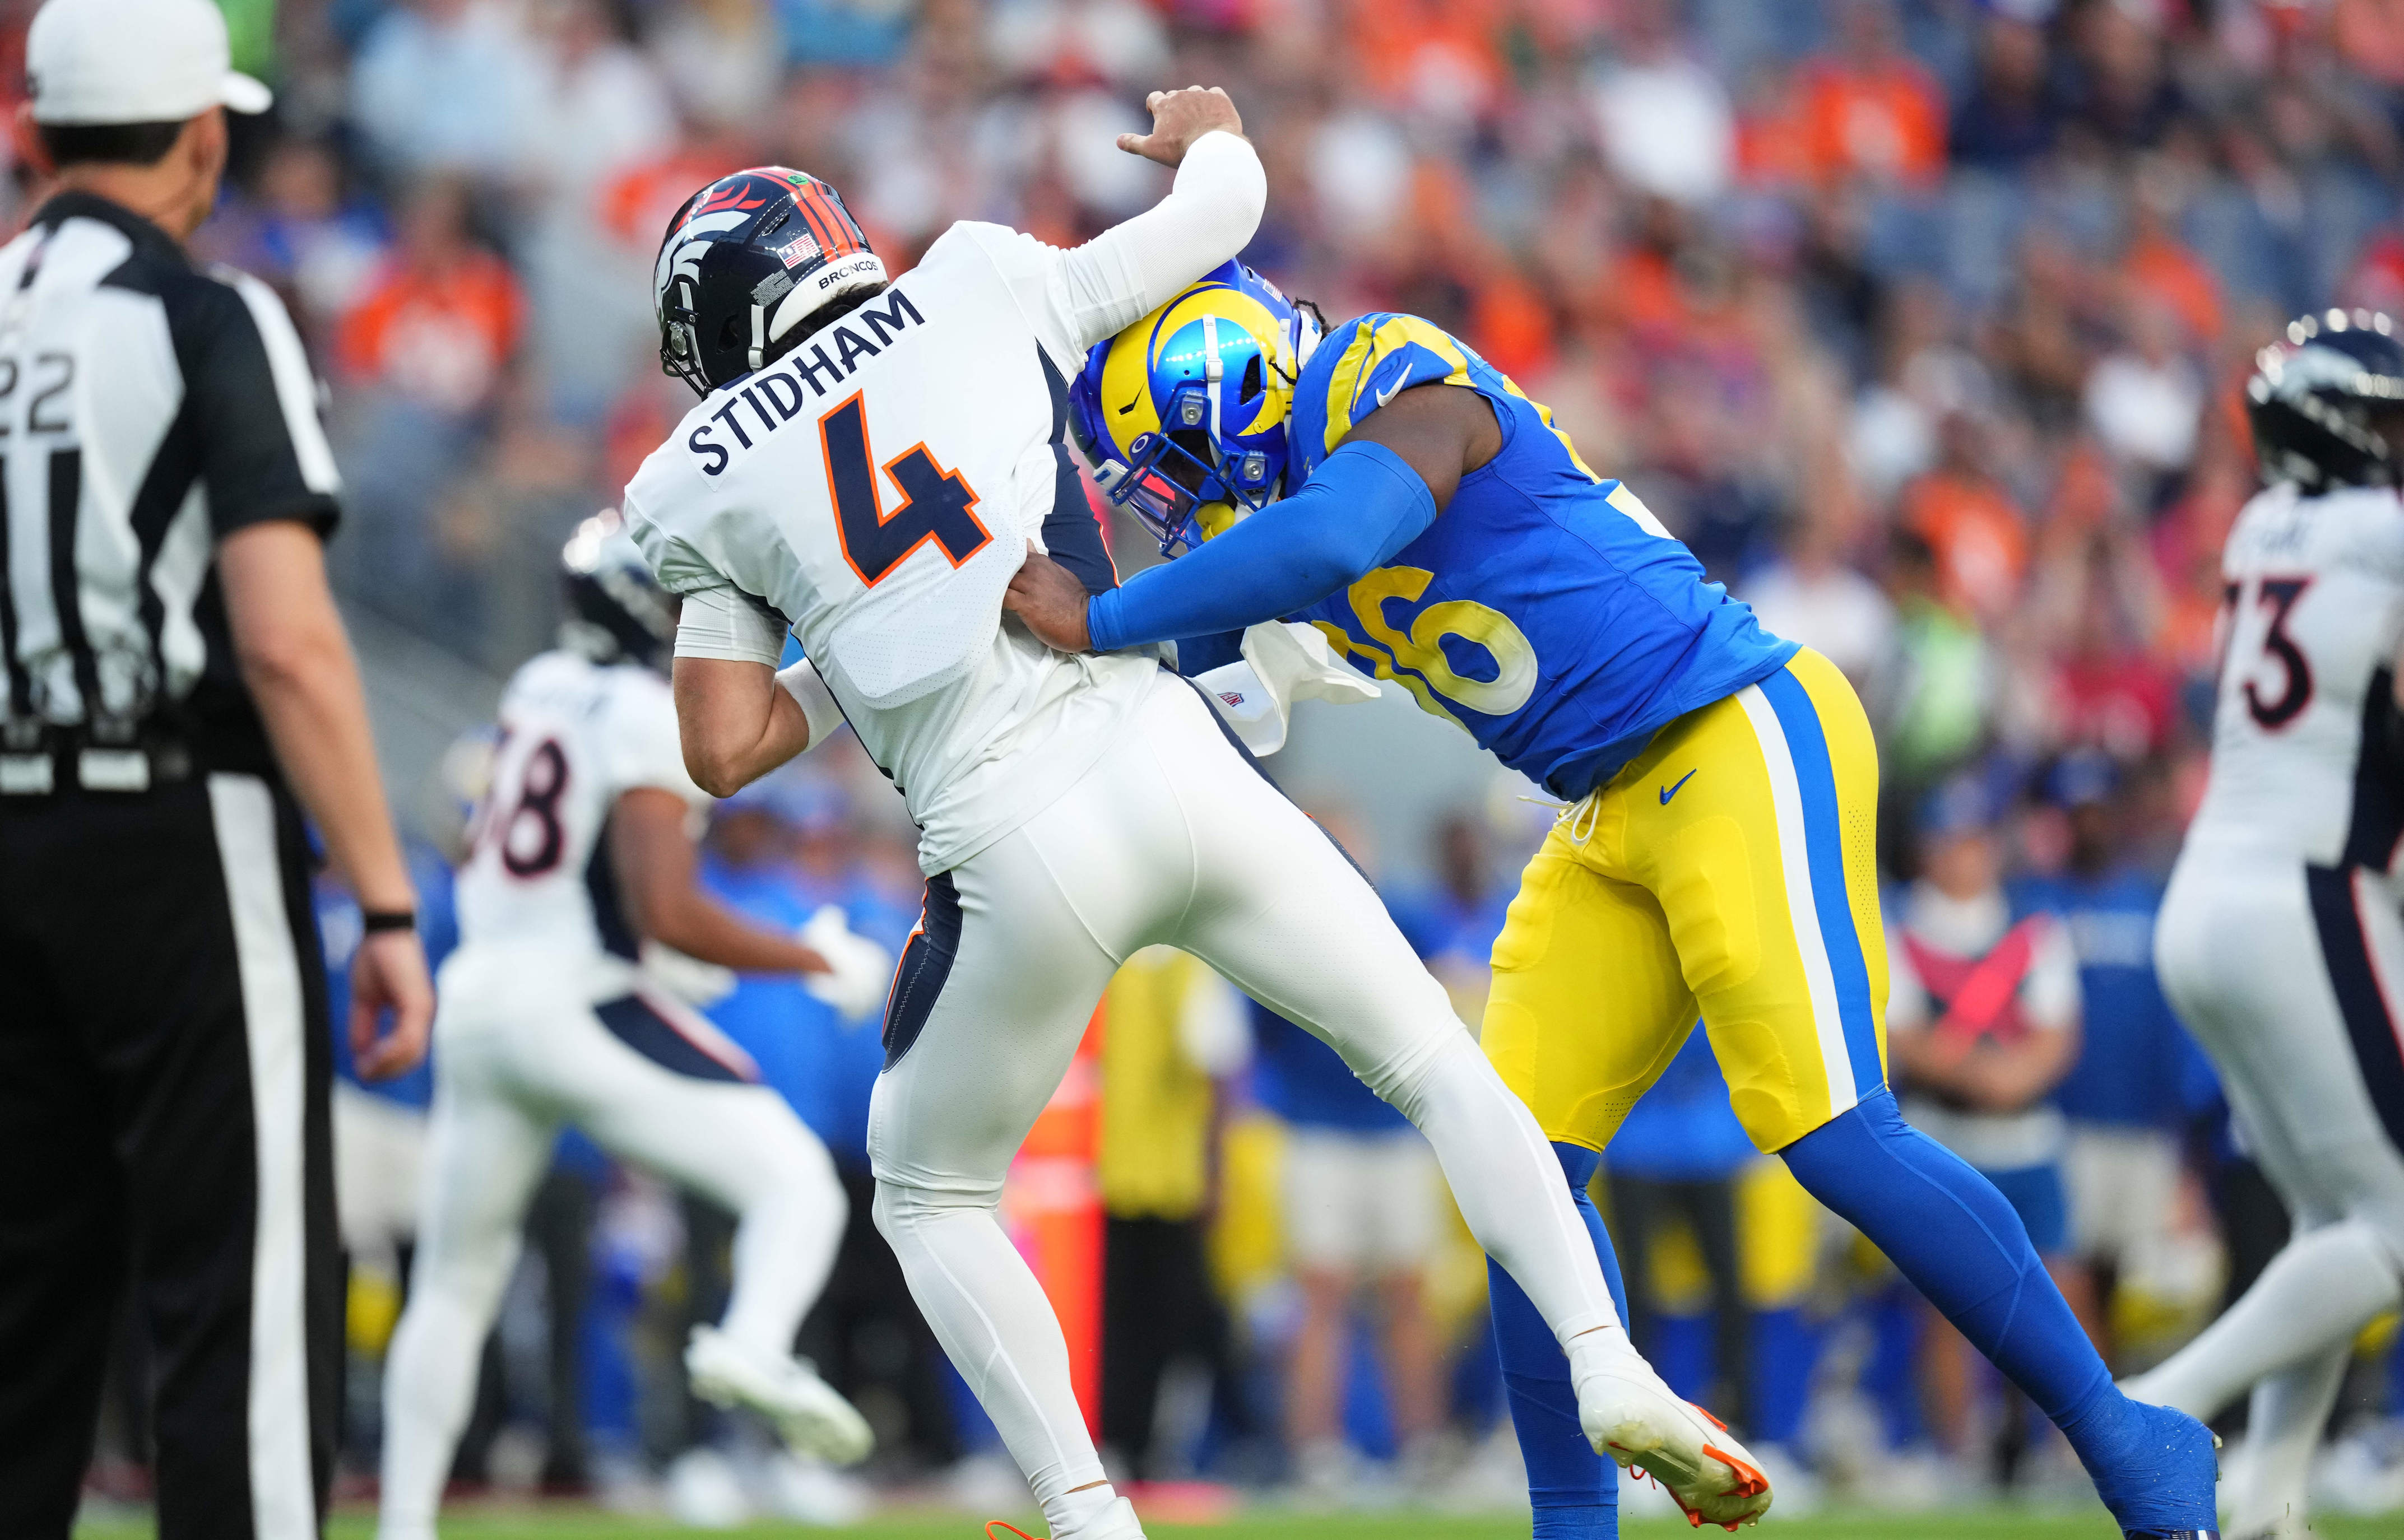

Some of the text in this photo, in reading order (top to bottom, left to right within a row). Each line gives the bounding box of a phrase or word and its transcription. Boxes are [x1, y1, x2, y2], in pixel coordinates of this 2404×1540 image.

[818, 260, 878, 290] BRONCOS
[688, 289, 926, 476] STIDHAM
[817, 388, 994, 589] 4
[2222, 575, 2318, 733] 3
